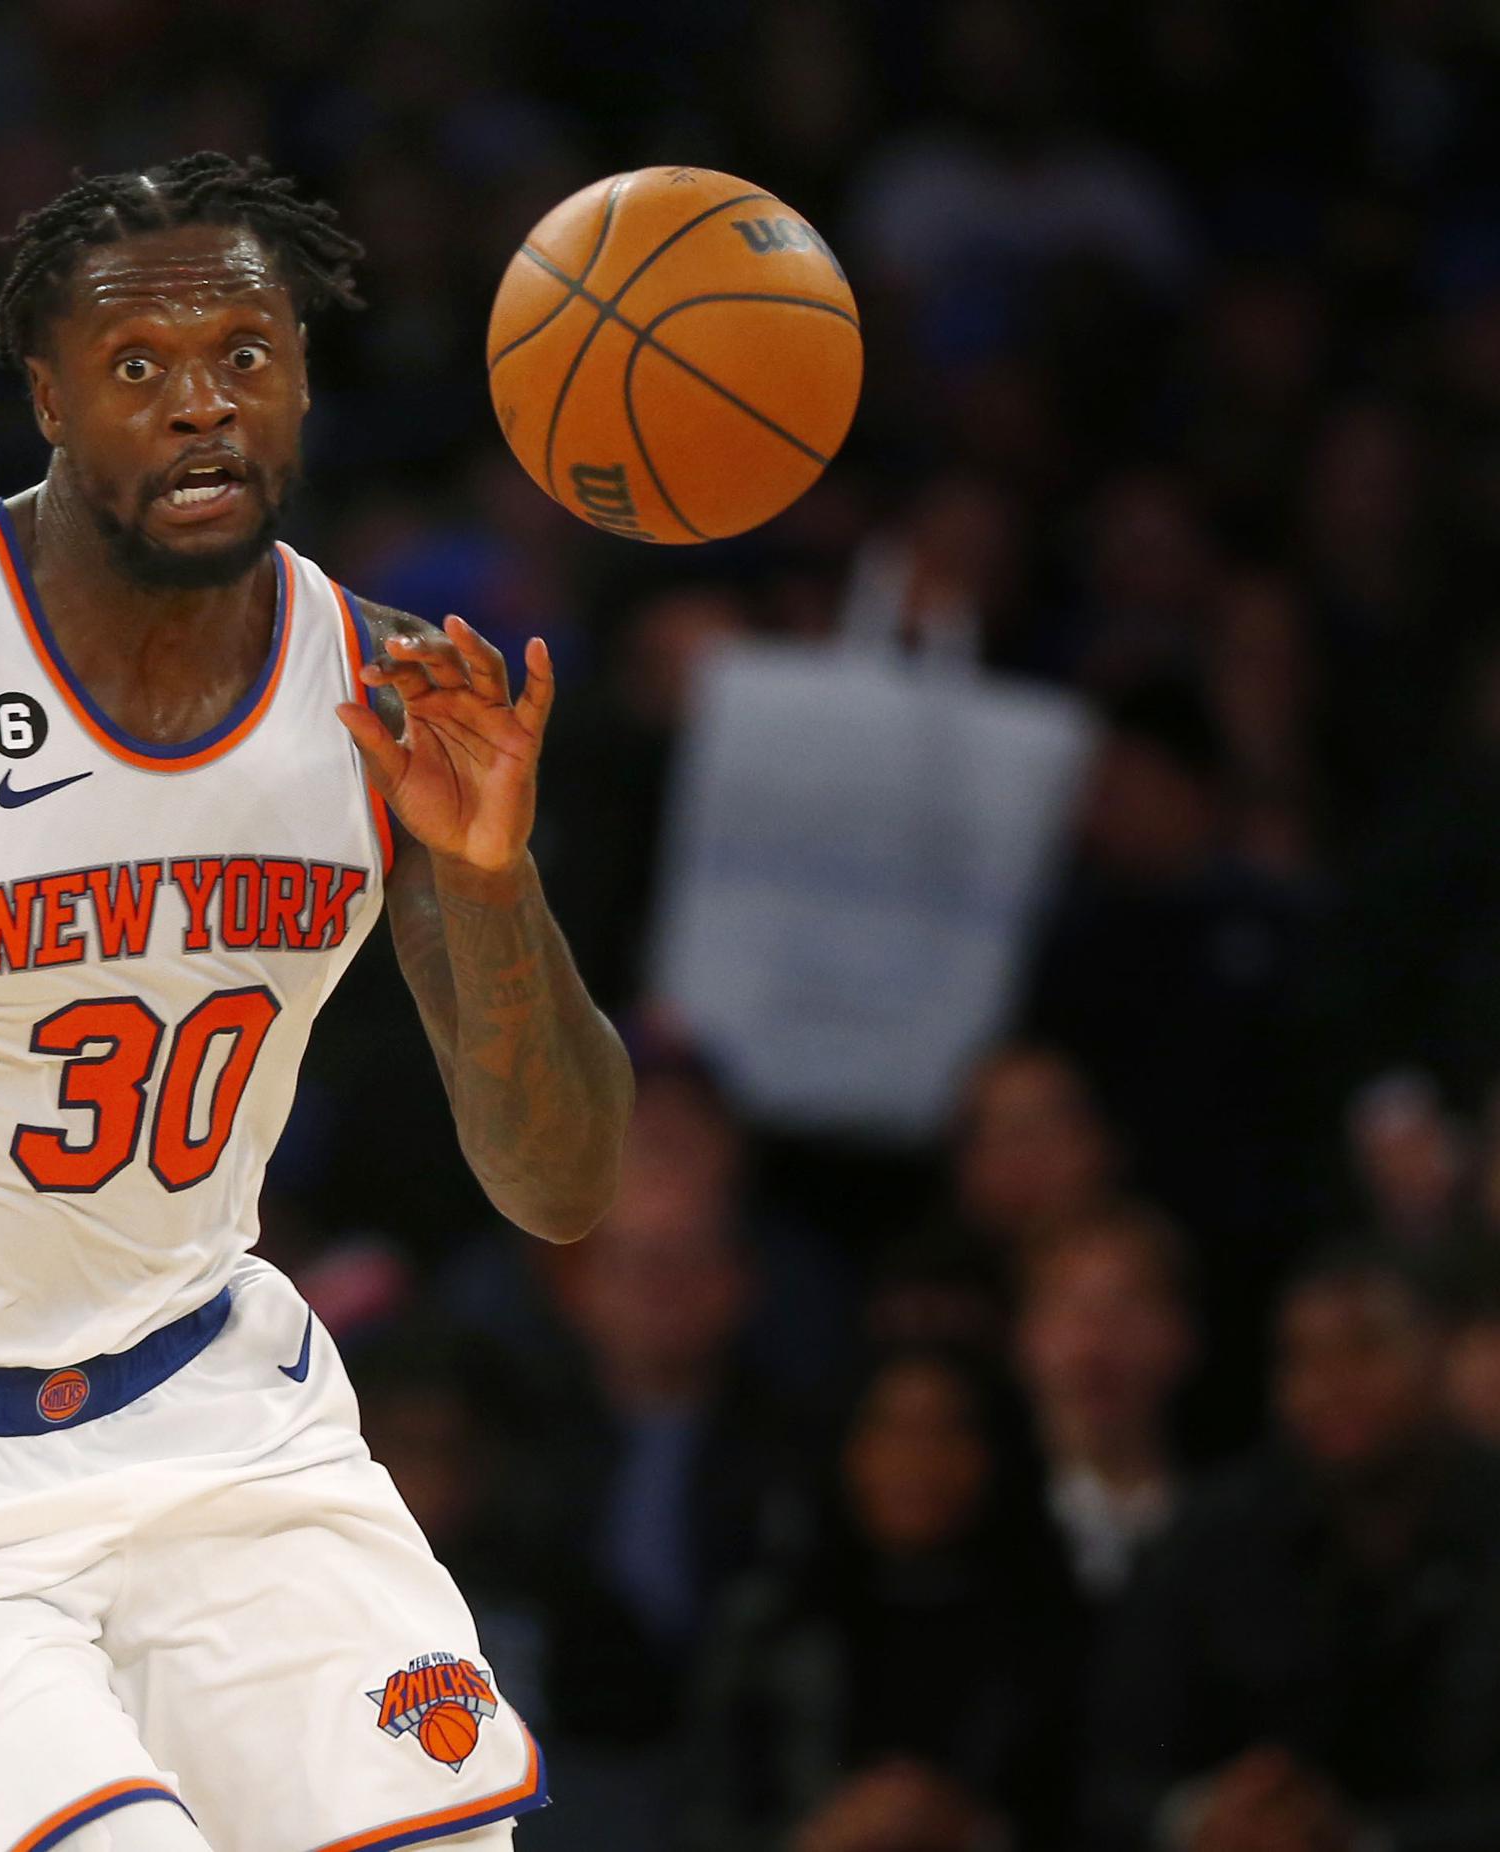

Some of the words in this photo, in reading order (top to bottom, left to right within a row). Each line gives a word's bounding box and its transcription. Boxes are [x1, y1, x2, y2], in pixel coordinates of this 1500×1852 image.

[167, 854, 369, 954] YORK
[9, 984, 282, 1194] 30
[377, 1658, 498, 1734] KNICKS
